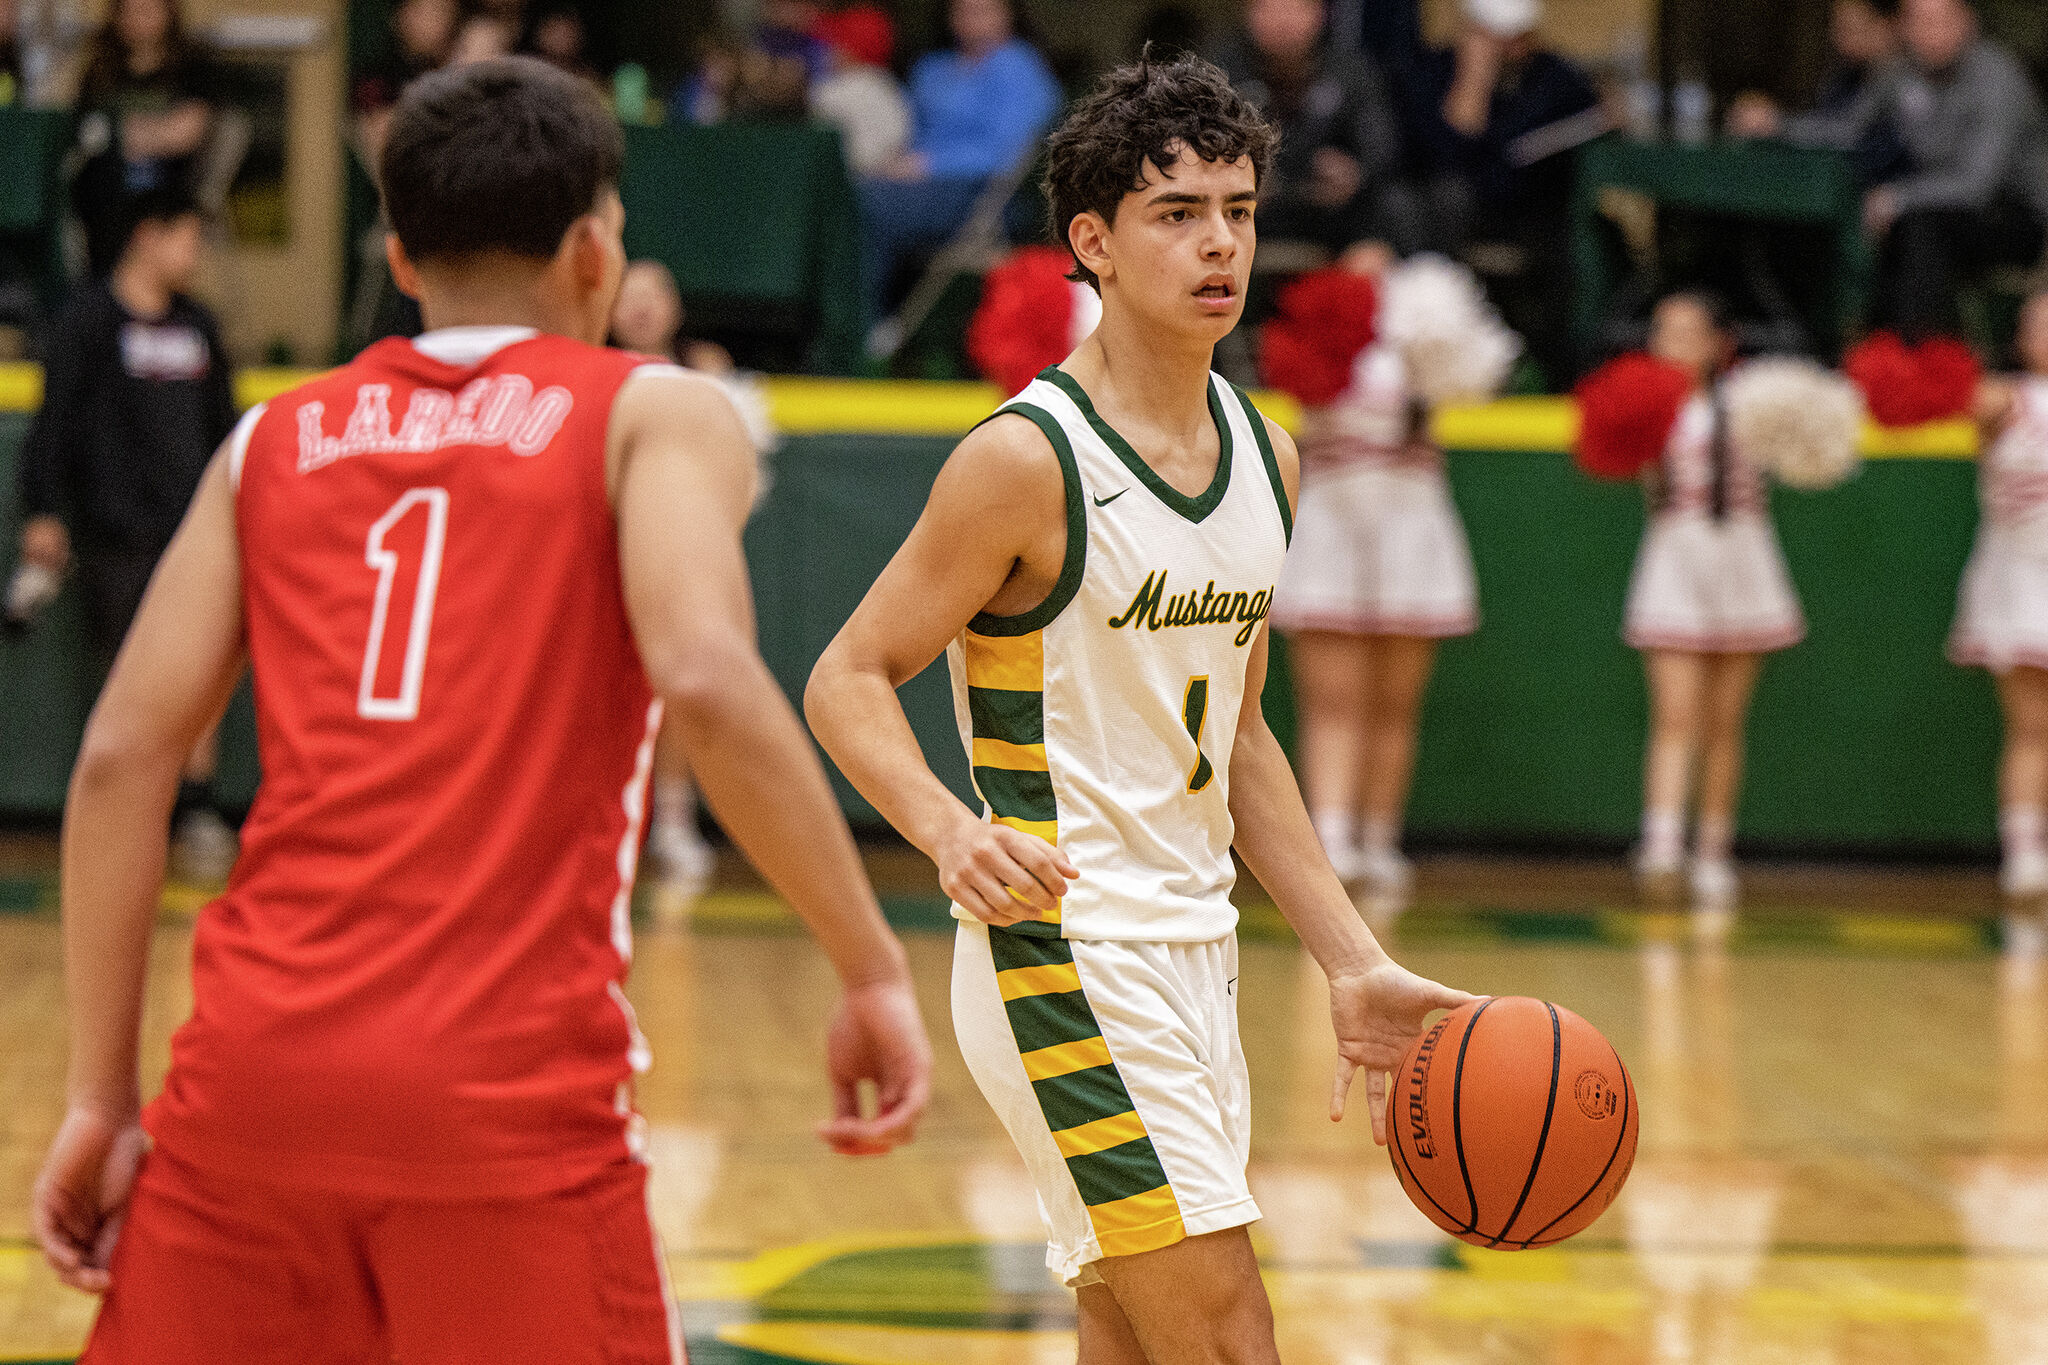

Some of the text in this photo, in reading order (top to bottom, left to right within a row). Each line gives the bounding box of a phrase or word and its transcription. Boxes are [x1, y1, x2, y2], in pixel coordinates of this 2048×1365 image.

[297, 373, 574, 475] LAREDO
[357, 486, 450, 721] 1
[1182, 674, 1214, 795] 1
[1409, 1016, 1450, 1160] EVOLUTION
